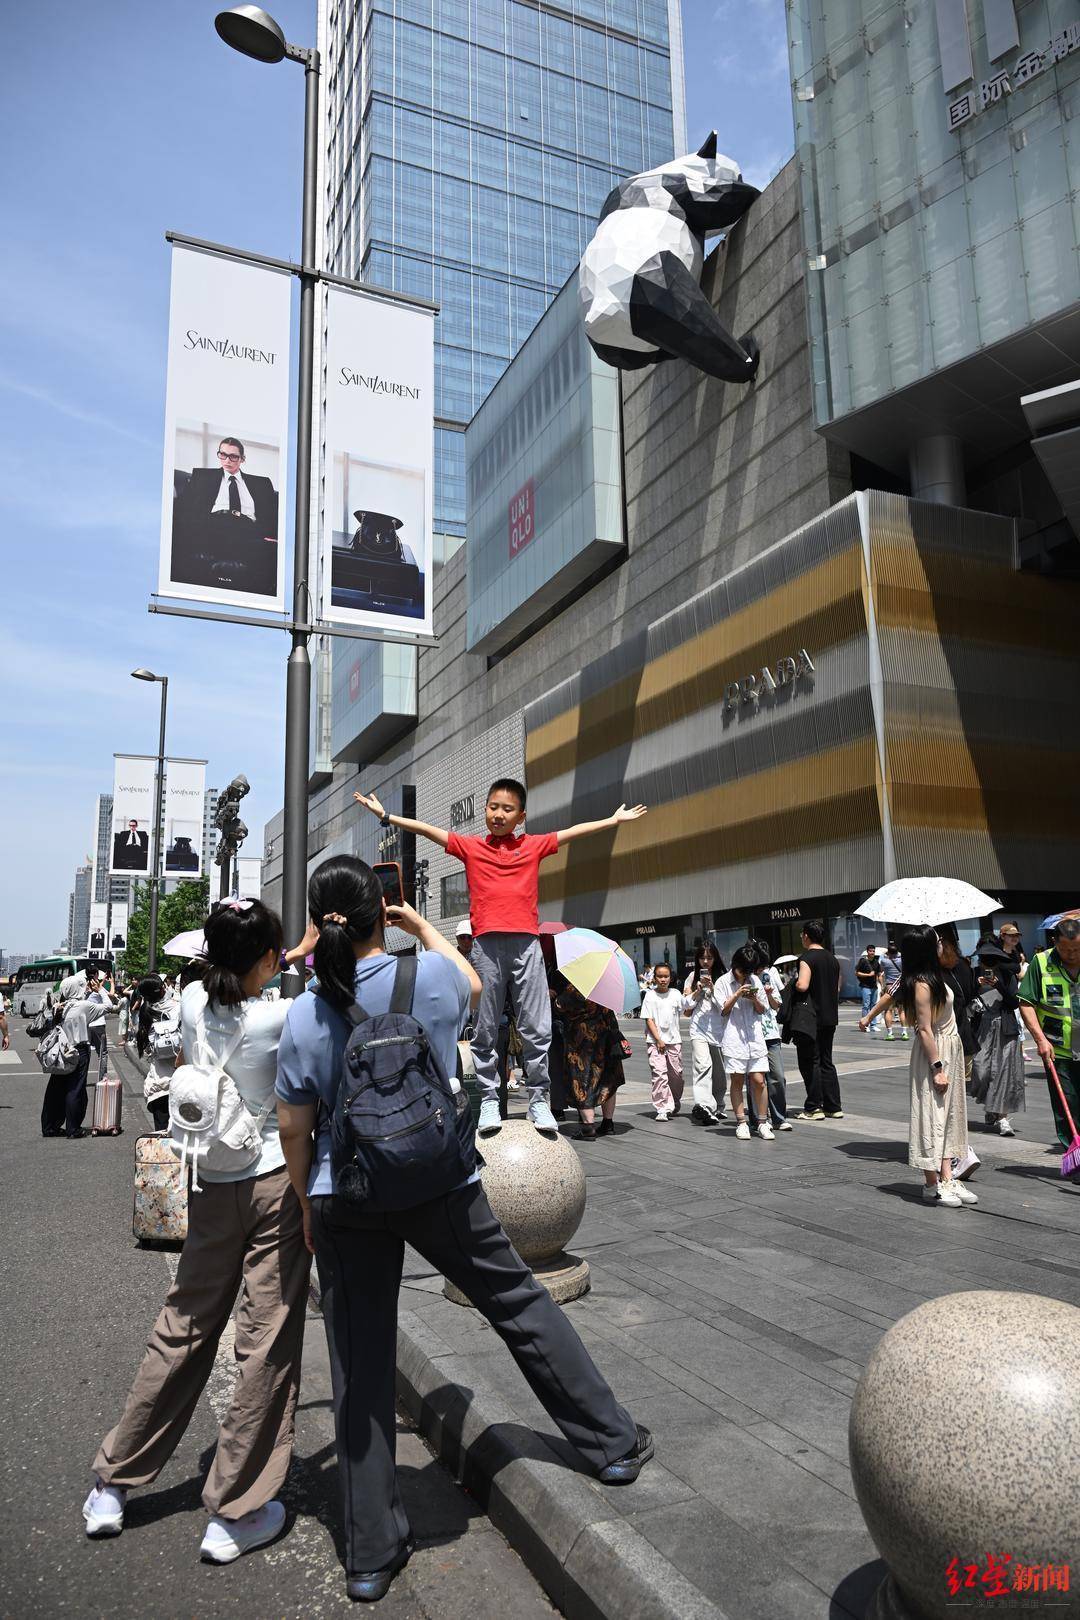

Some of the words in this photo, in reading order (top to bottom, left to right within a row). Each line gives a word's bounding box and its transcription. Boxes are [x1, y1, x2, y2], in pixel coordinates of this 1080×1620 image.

[511, 490, 529, 524] UNI
[511, 514, 531, 550] QLO
[723, 648, 816, 709] PRADA
[771, 907, 801, 920] PRADA
